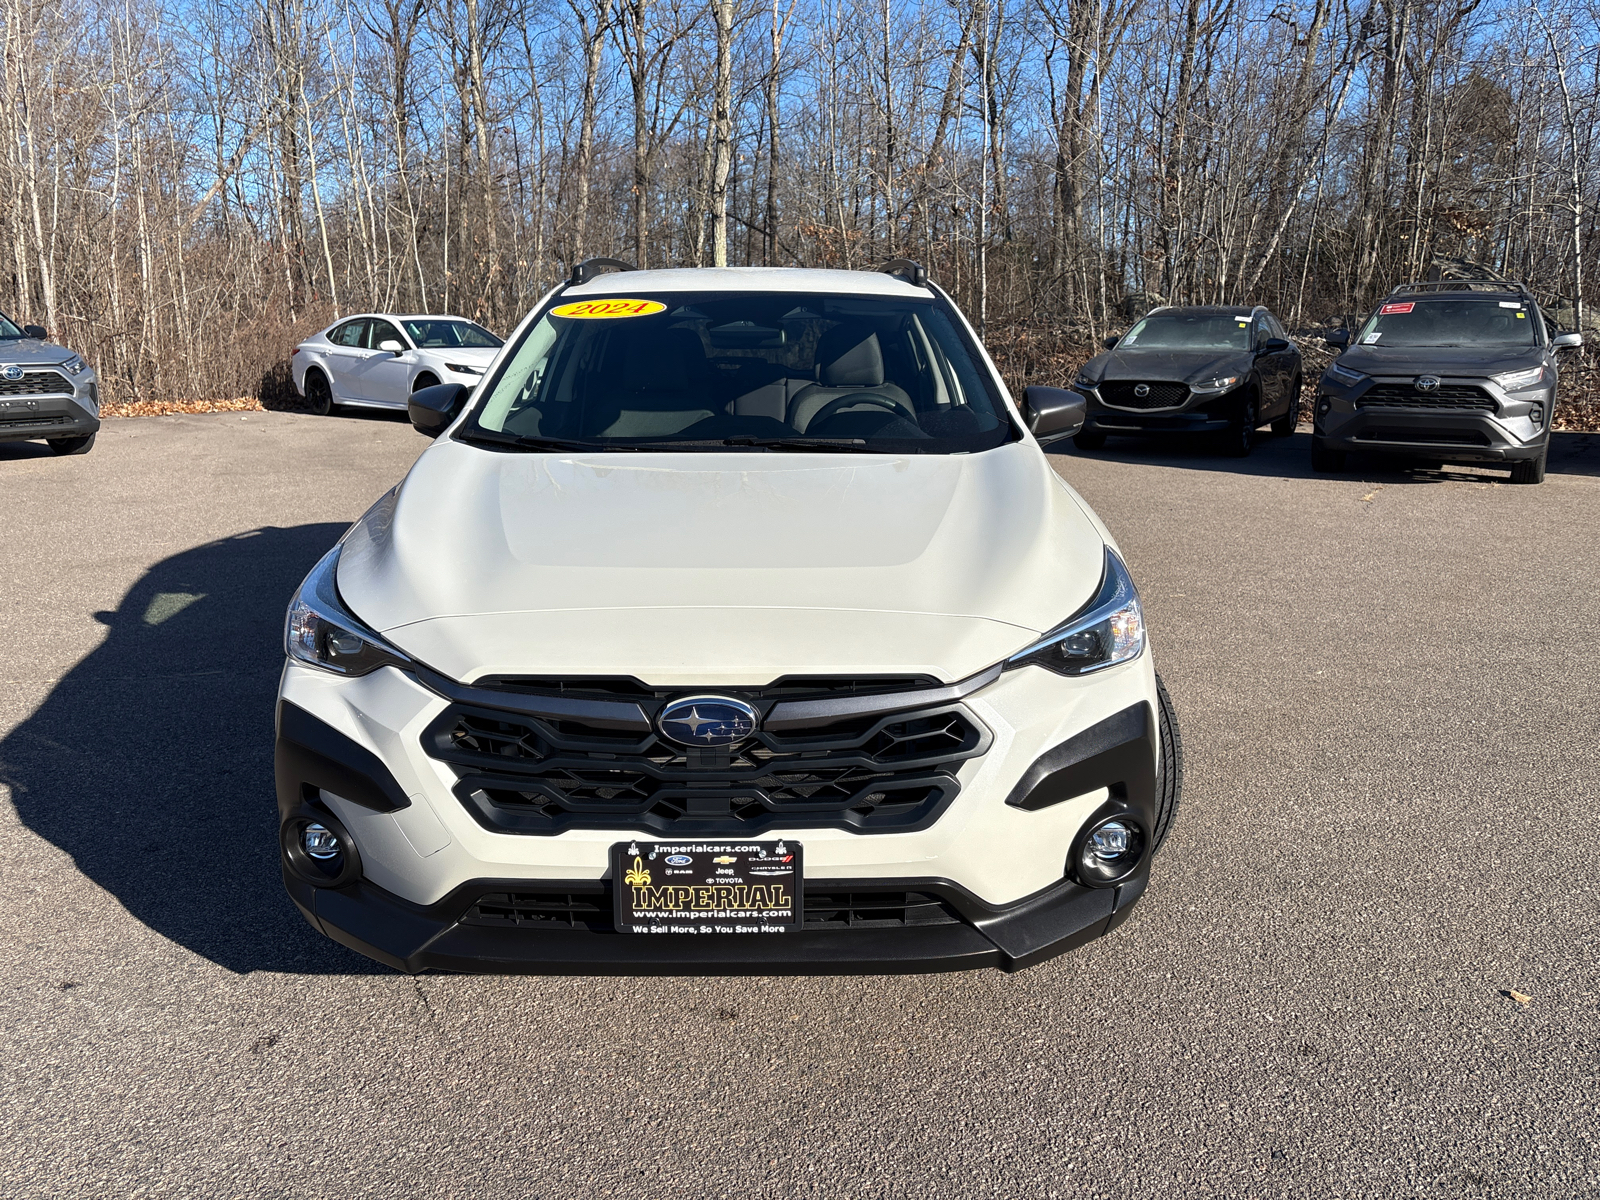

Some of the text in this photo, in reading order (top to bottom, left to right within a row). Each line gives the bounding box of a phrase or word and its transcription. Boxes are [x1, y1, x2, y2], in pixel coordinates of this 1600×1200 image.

[567, 303, 649, 315] 2024
[654, 844, 761, 854] Imperialcars.com
[715, 867, 734, 875] Jeep
[632, 885, 791, 909] IMPERIAL
[633, 910, 791, 919] www.imperialcars.com
[670, 926, 697, 934] More,
